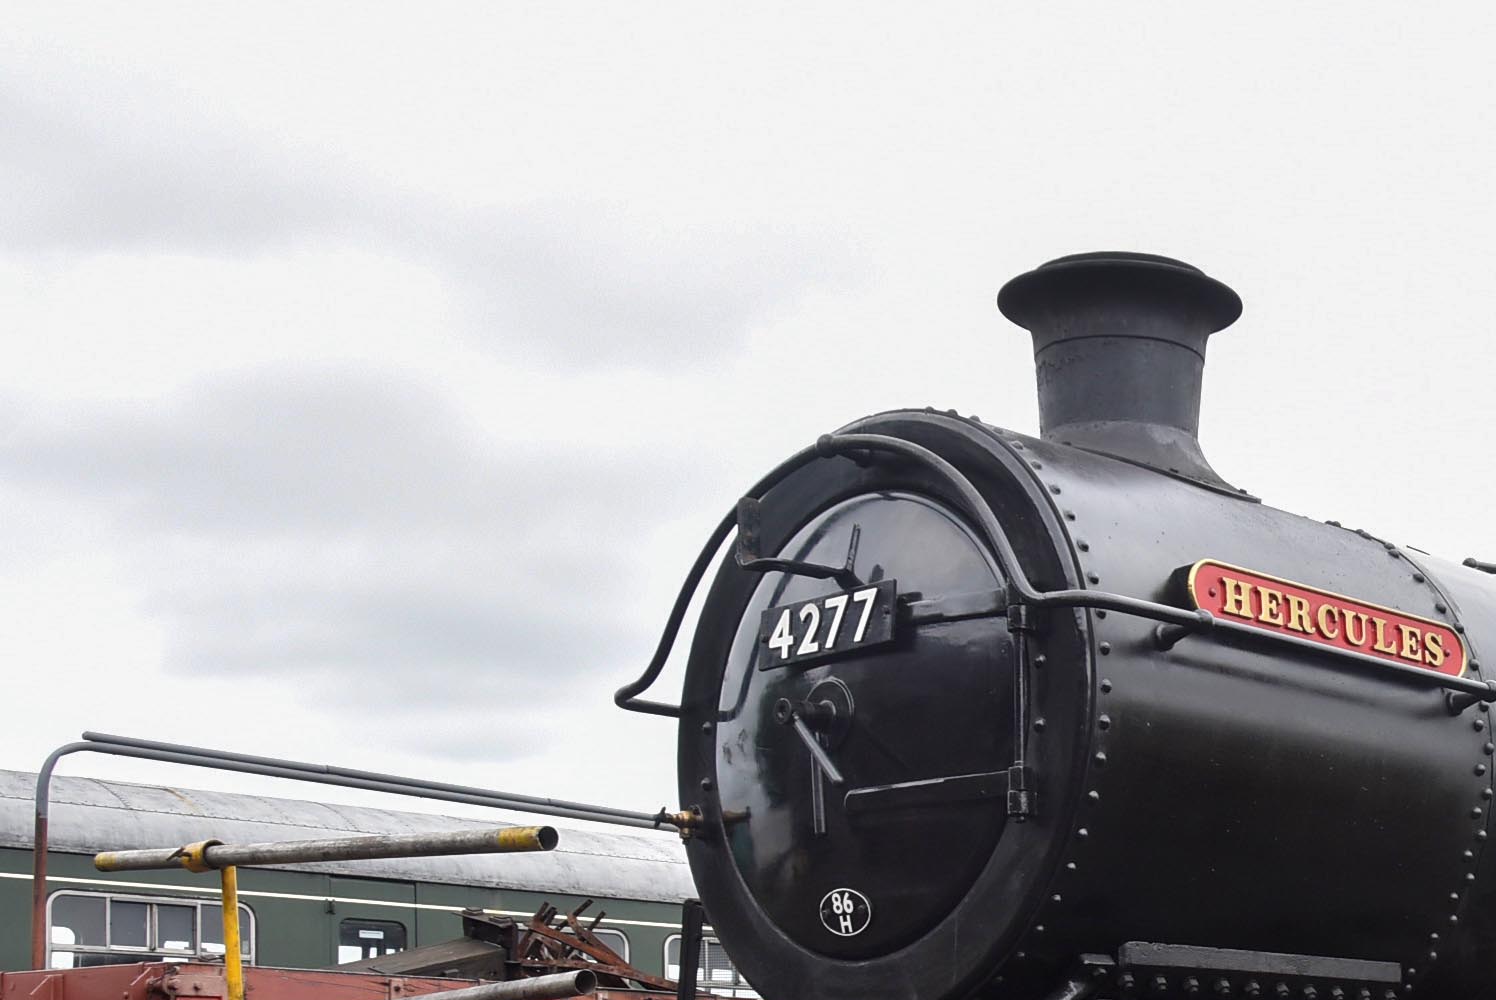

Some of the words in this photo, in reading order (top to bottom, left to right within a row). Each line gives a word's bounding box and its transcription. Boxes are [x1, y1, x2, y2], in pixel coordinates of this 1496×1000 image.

[768, 587, 878, 660] 4277
[1222, 576, 1444, 667] HERCULES
[831, 892, 854, 914] 86
[839, 914, 853, 934] H
